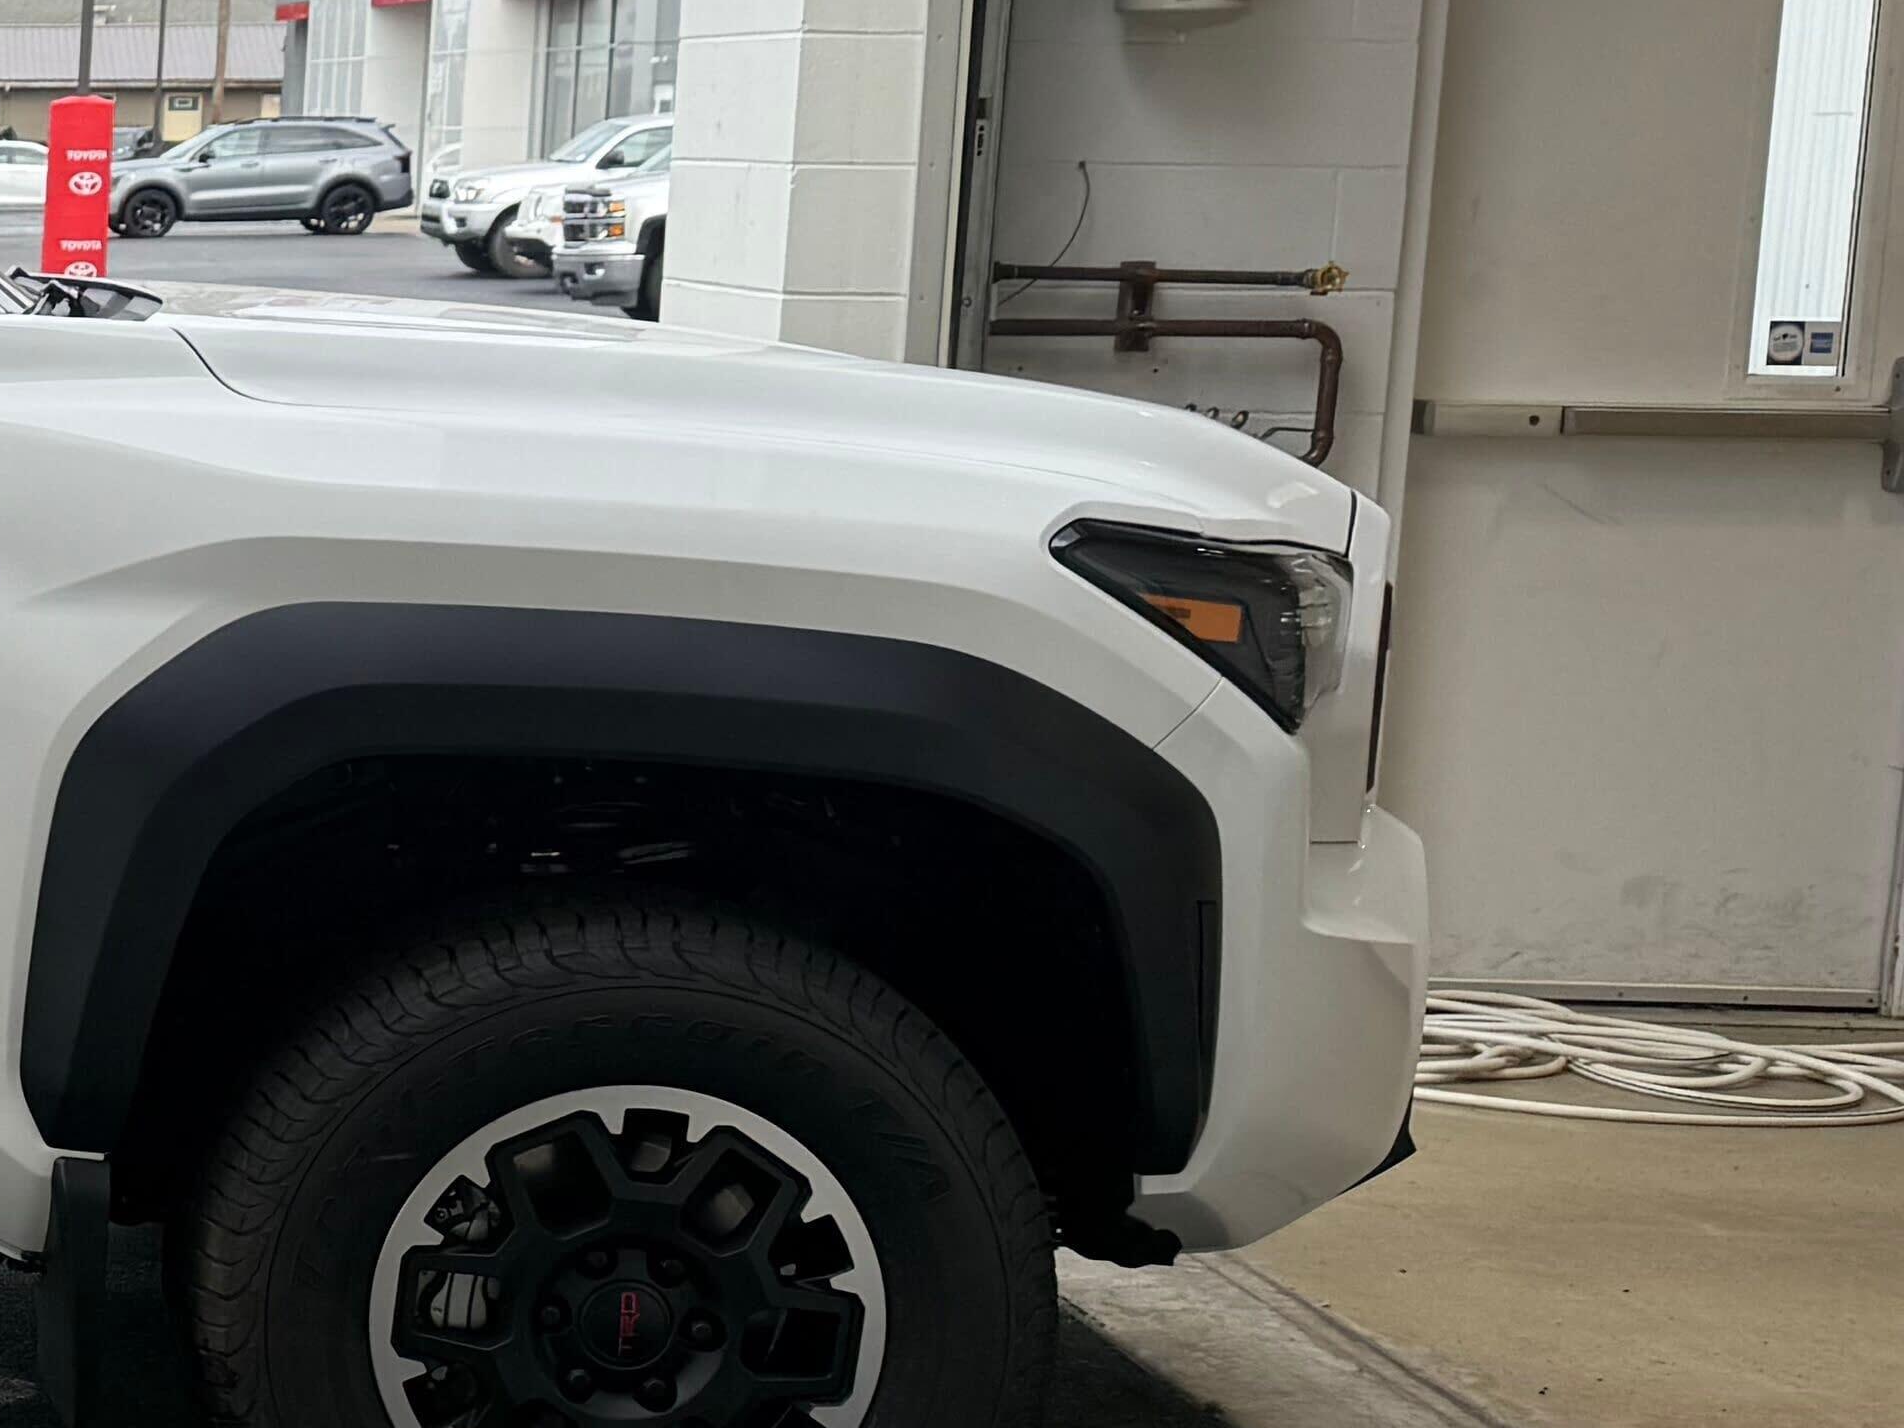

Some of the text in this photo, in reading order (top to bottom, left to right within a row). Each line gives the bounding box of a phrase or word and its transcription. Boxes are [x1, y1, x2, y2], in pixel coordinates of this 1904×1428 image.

[66, 149, 107, 160] TOYOTA
[59, 239, 102, 251] TOYOTA
[618, 1292, 640, 1357] TRD
